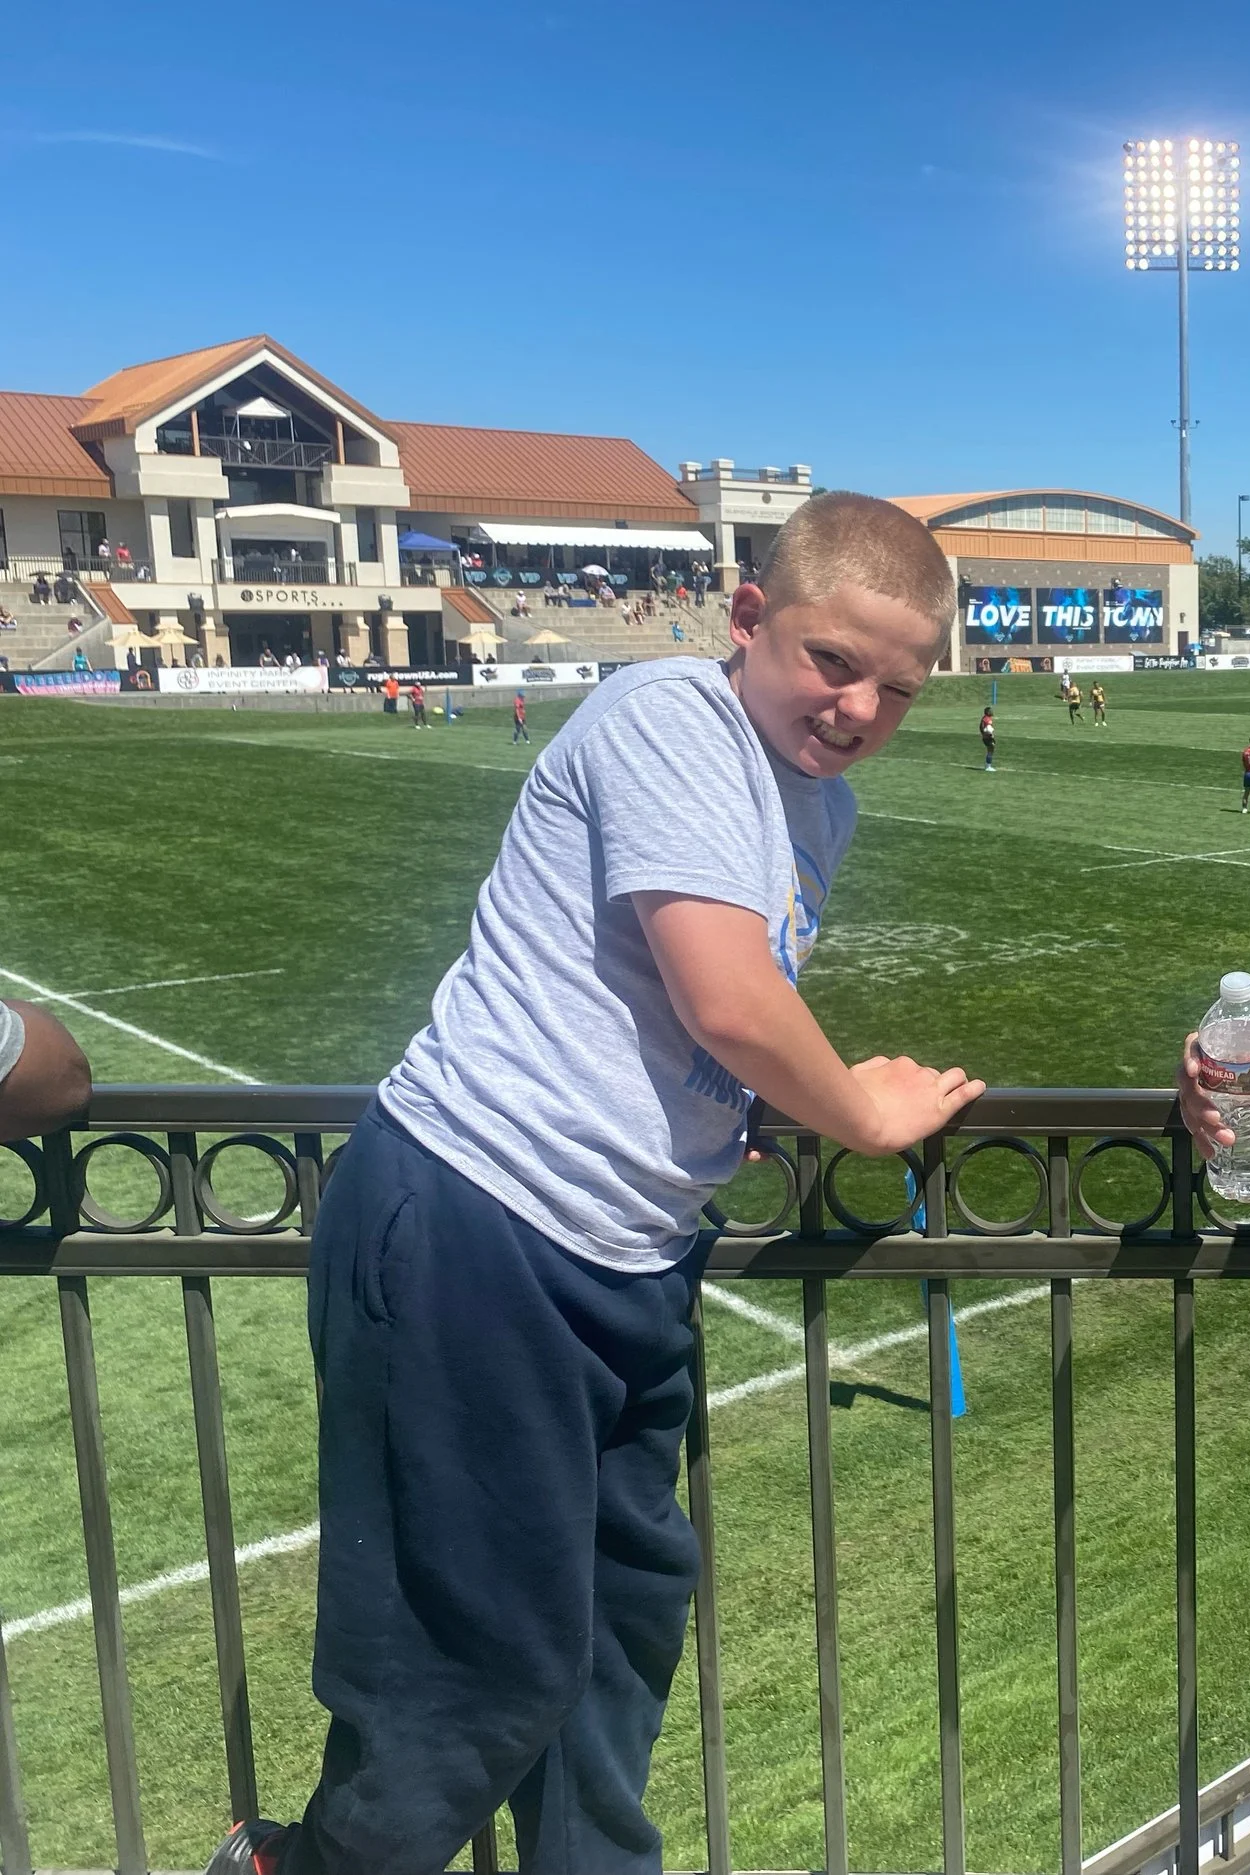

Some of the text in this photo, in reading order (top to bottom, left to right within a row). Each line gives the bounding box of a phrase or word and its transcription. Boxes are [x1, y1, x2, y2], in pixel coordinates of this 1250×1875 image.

[519, 572, 541, 583] VIP
[556, 573, 578, 584] VIP
[256, 589, 318, 603] SPORTS
[966, 605, 1031, 626] LOVE
[1042, 606, 1094, 626] THIS
[1103, 607, 1163, 627] TOWN
[207, 670, 257, 678] INFINITY
[367, 670, 458, 681] rugbtownUSA.com
[209, 680, 298, 688] EVENT CENTER
[1200, 1063, 1234, 1080] ROWHEAD
